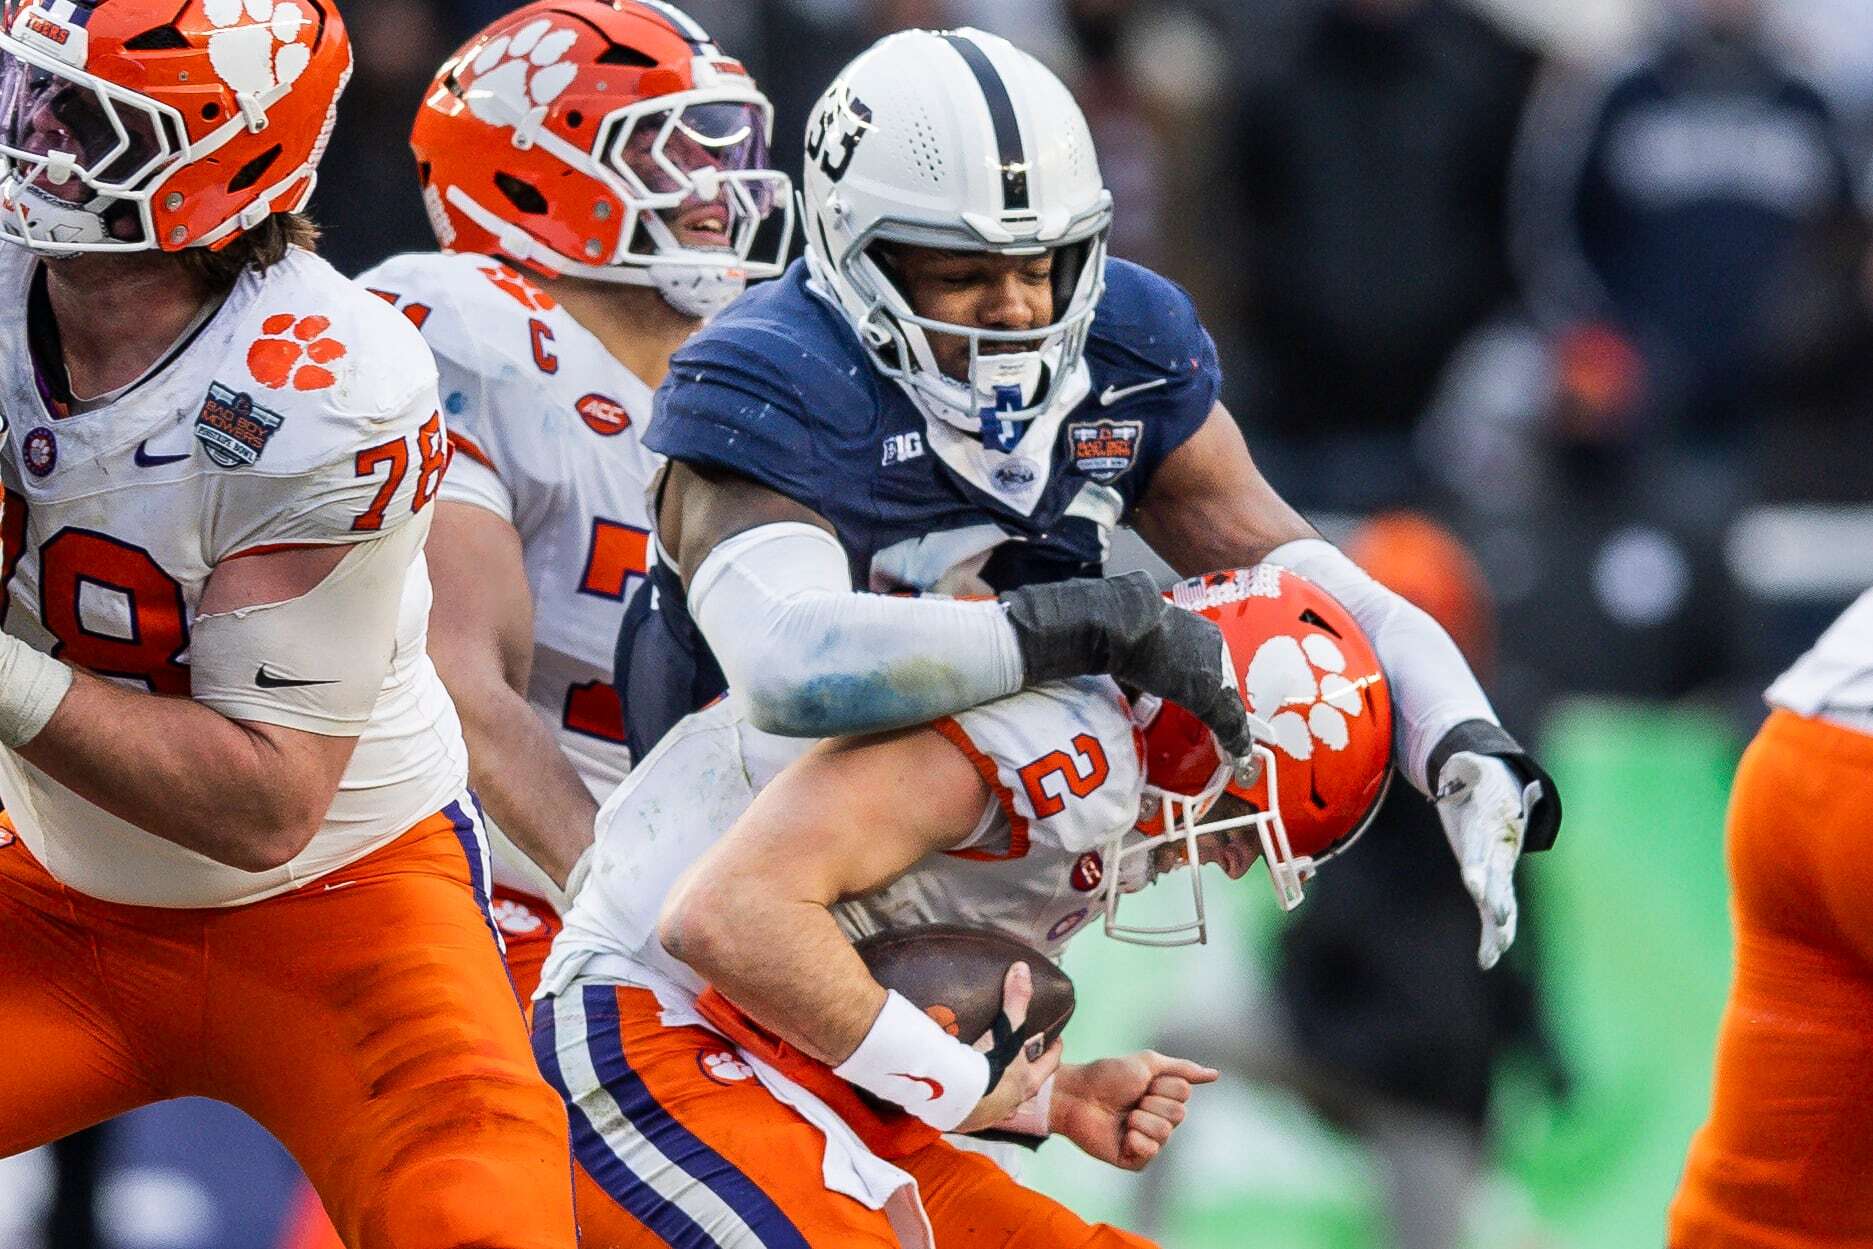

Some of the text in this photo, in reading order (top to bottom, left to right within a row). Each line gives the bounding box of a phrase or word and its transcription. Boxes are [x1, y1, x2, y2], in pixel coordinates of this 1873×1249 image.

[528, 318, 559, 375] C
[200, 409, 265, 449] MOWERS
[205, 400, 268, 437] BAD BOY
[580, 399, 625, 425] ACC
[350, 408, 452, 532] 78
[1016, 732, 1110, 820] 2
